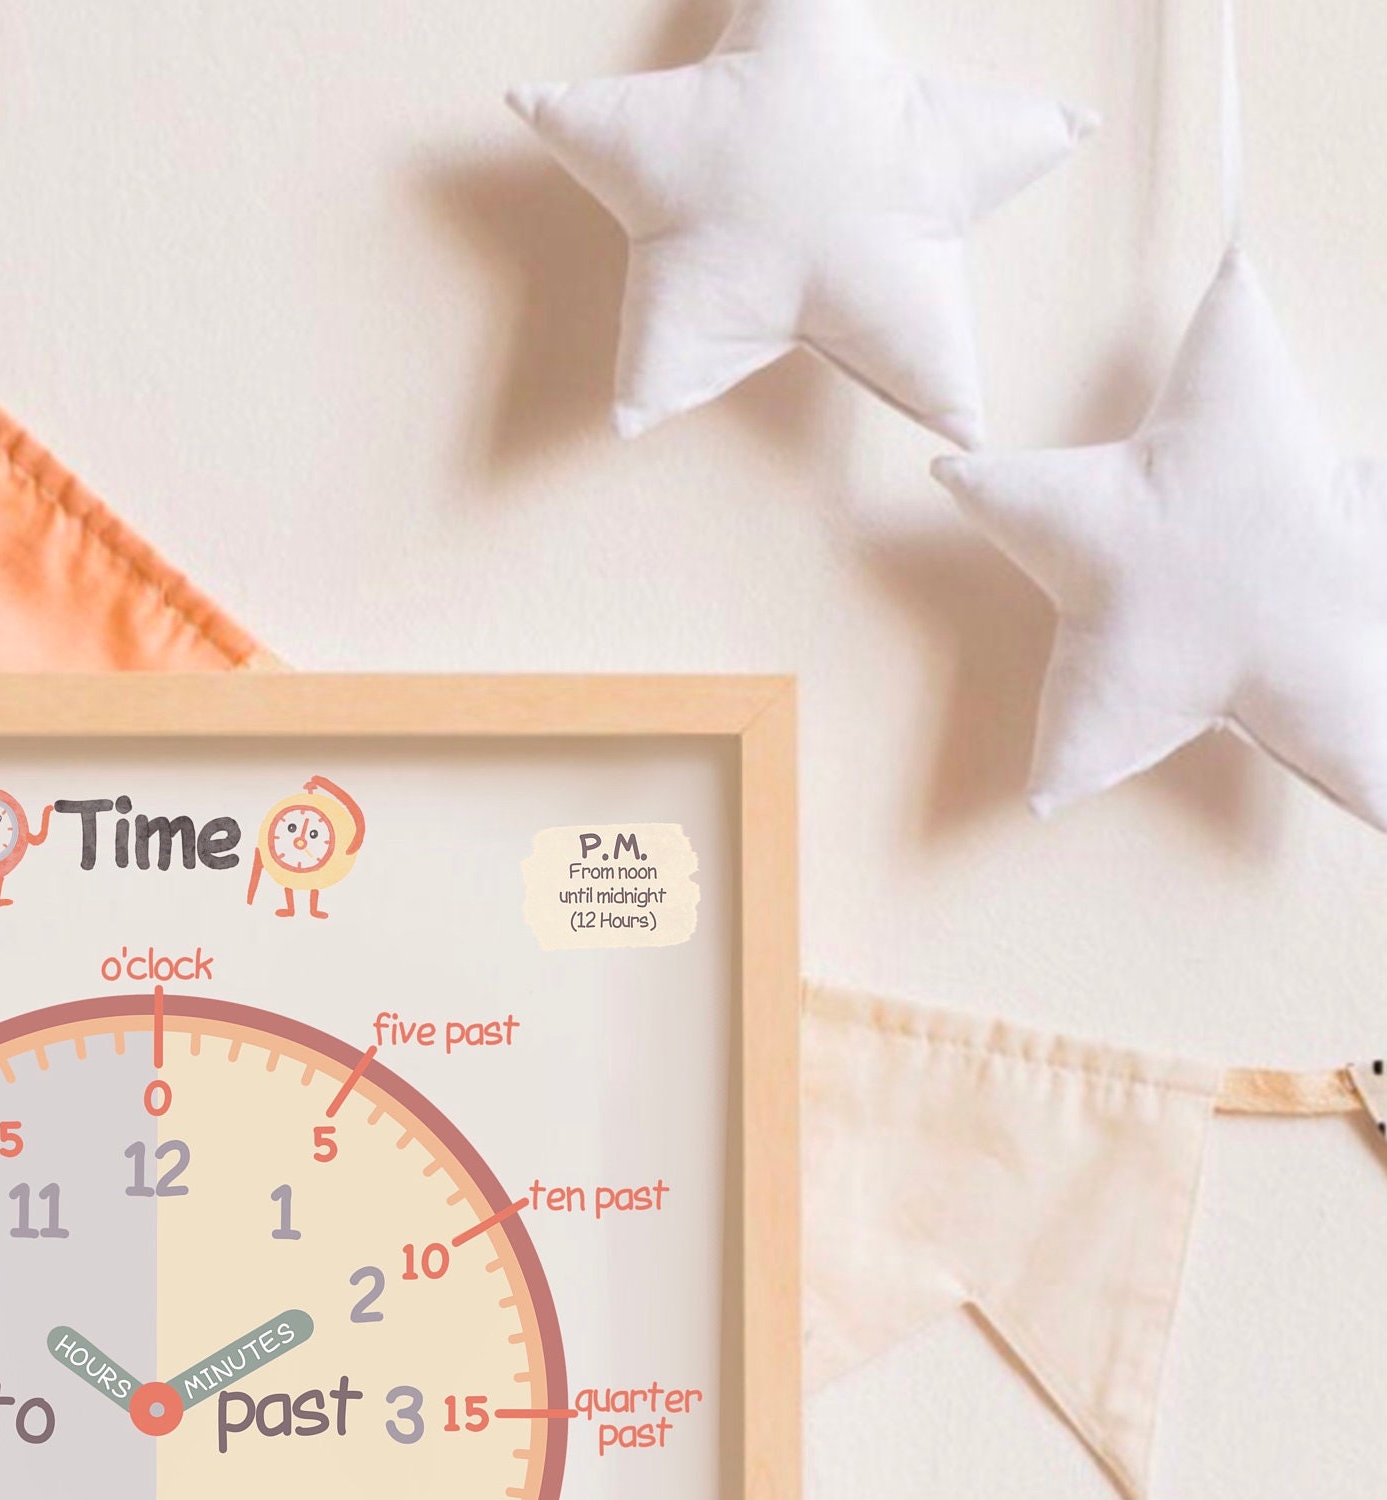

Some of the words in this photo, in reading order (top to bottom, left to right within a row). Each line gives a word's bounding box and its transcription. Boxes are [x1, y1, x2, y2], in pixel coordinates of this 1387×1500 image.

[54, 795, 241, 871] Time
[579, 833, 647, 861] P.M.
[570, 863, 614, 879] From
[618, 867, 657, 879] noon
[560, 887, 592, 904] until
[597, 887, 666, 908] midnight
[571, 911, 596, 932] (12
[601, 911, 656, 931] Hours)
[101, 946, 213, 981] o'clock
[373, 1012, 436, 1046] five
[446, 1015, 520, 1054] past
[144, 1080, 172, 1116] 0
[313, 1126, 337, 1162] 5
[124, 1140, 190, 1197] 12
[9, 1183, 69, 1238] 11
[271, 1184, 301, 1240] 1
[529, 1180, 585, 1212] ten
[596, 1180, 669, 1219] past
[402, 1243, 449, 1280] 10
[350, 1266, 385, 1323] 2
[55, 1334, 131, 1399] HOURS
[184, 1323, 295, 1399] MINUTES
[218, 1376, 363, 1453] past
[386, 1386, 424, 1444] 3
[444, 1395, 489, 1432] 15
[574, 1382, 703, 1421] quarter
[599, 1417, 673, 1456] past
